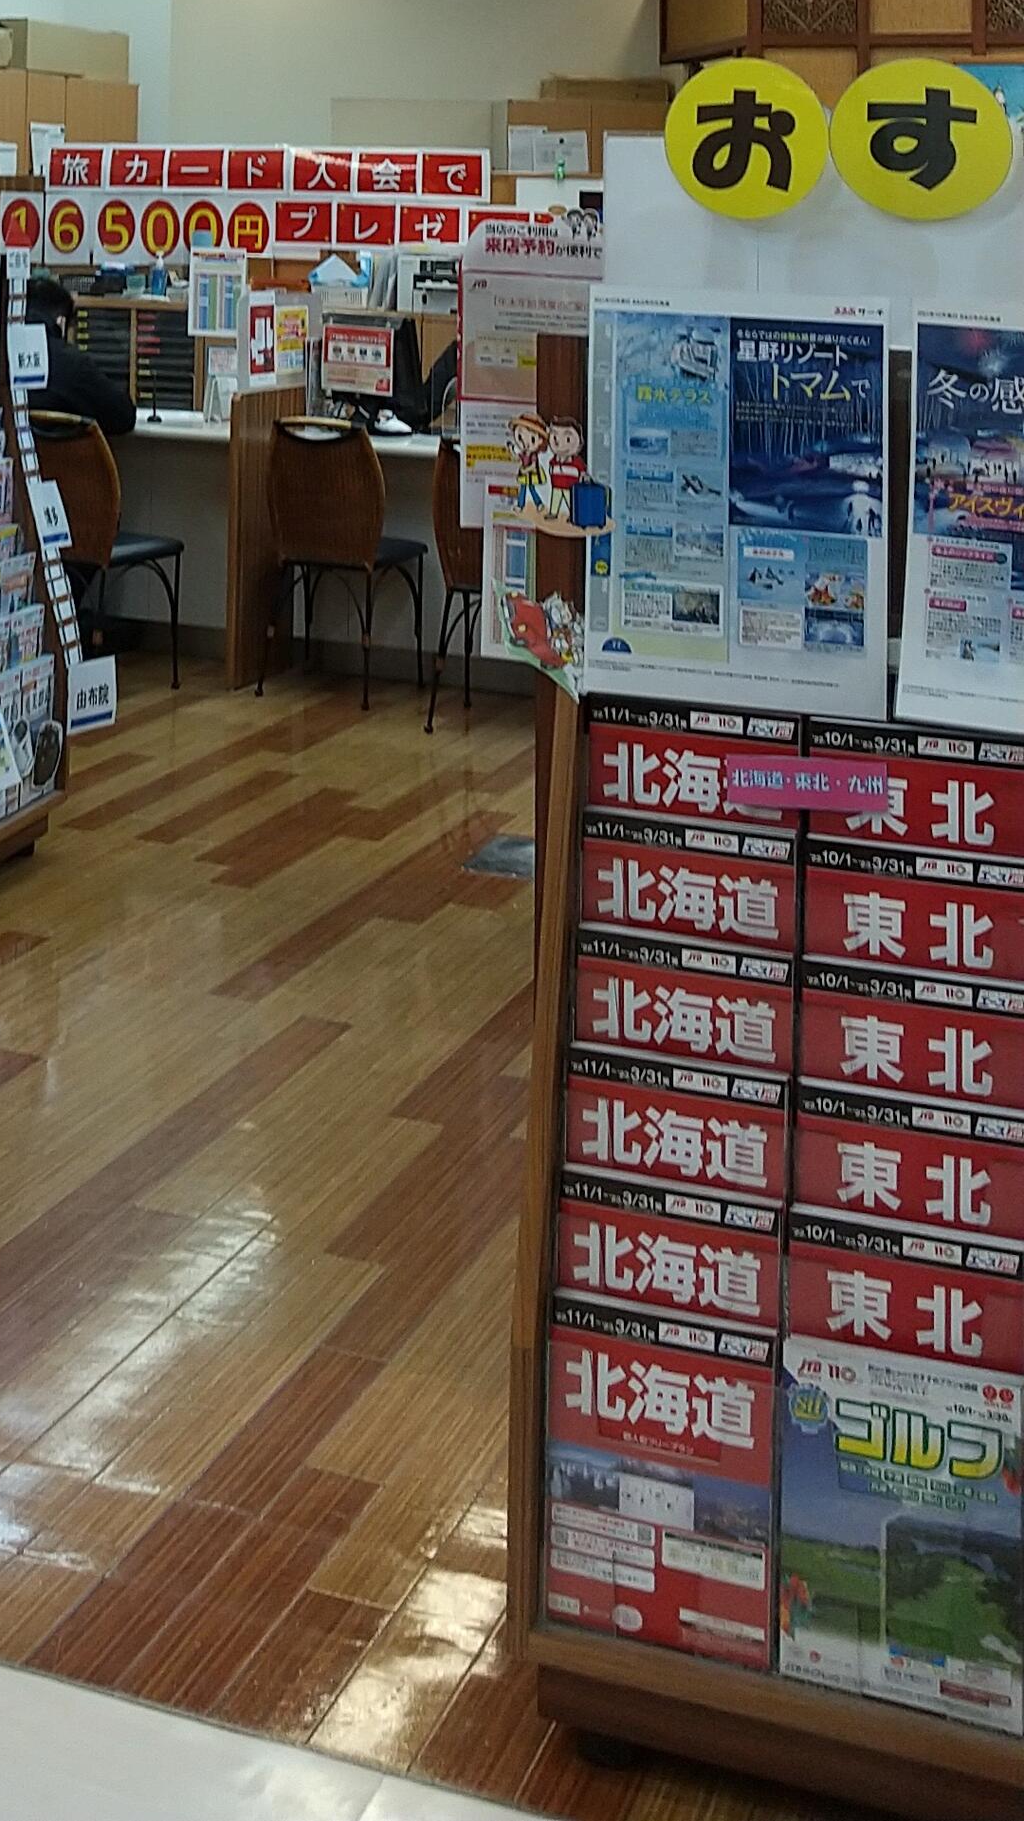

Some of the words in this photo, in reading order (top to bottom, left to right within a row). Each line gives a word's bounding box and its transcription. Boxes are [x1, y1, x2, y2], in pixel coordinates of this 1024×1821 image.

[61, 152, 467, 193] 旅カード入会で
[736, 340, 848, 366] 星野リゾート
[771, 363, 871, 401] トマムで
[76, 684, 110, 709] 由布院
[603, 741, 783, 820] 北海
[731, 768, 884, 796] 北海道・東北・九州
[597, 857, 779, 941] 北海道
[843, 892, 994, 969] 東北
[592, 977, 776, 1063] 北海道
[840, 1015, 993, 1098] 東北
[582, 1097, 767, 1188] 北海道
[837, 1141, 991, 1227] 東北
[573, 1222, 760, 1317] 北海道
[827, 1269, 982, 1358] 東北
[566, 1348, 755, 1449] 北海道
[835, 1397, 1003, 1480] ゴルフ
